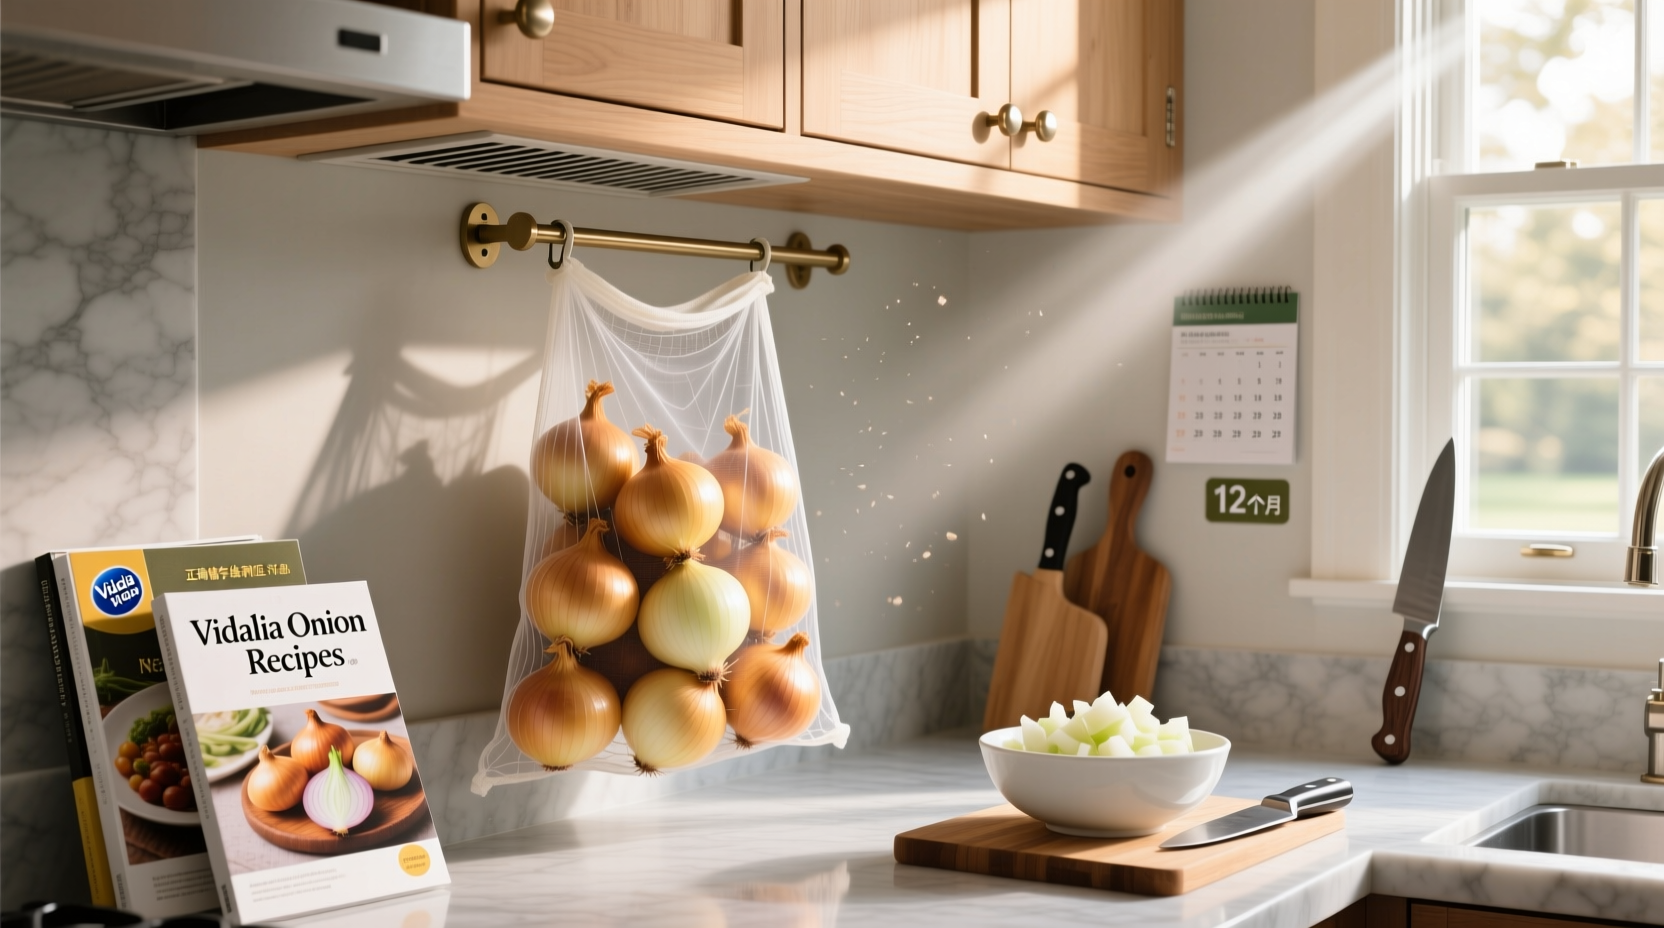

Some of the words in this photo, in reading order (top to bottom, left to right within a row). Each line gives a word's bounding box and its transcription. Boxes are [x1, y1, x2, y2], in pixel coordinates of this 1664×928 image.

[189, 613, 285, 646] Vidalia
[287, 609, 367, 638] Onion
[245, 644, 346, 678] Recipes
